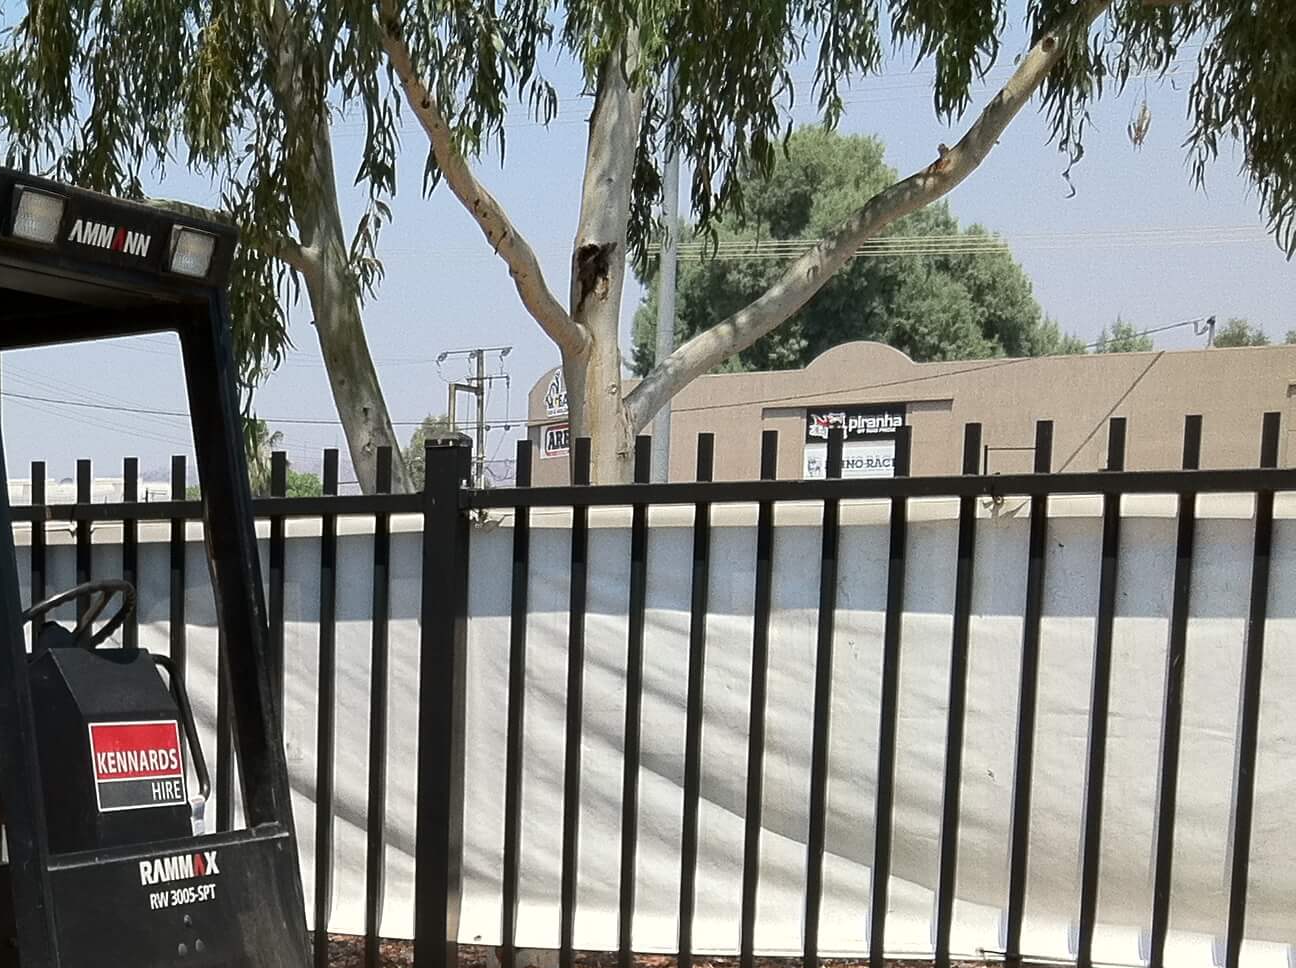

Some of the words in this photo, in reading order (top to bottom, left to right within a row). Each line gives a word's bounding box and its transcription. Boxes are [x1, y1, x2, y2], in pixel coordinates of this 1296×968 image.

[68, 219, 151, 257] AMMANN
[848, 412, 903, 433] piranha
[96, 748, 178, 774] KENNARDS
[151, 780, 182, 801] HIRE
[139, 851, 220, 886] RAMMAX
[150, 891, 169, 910] RW
[170, 884, 217, 906] 3005-SPT
